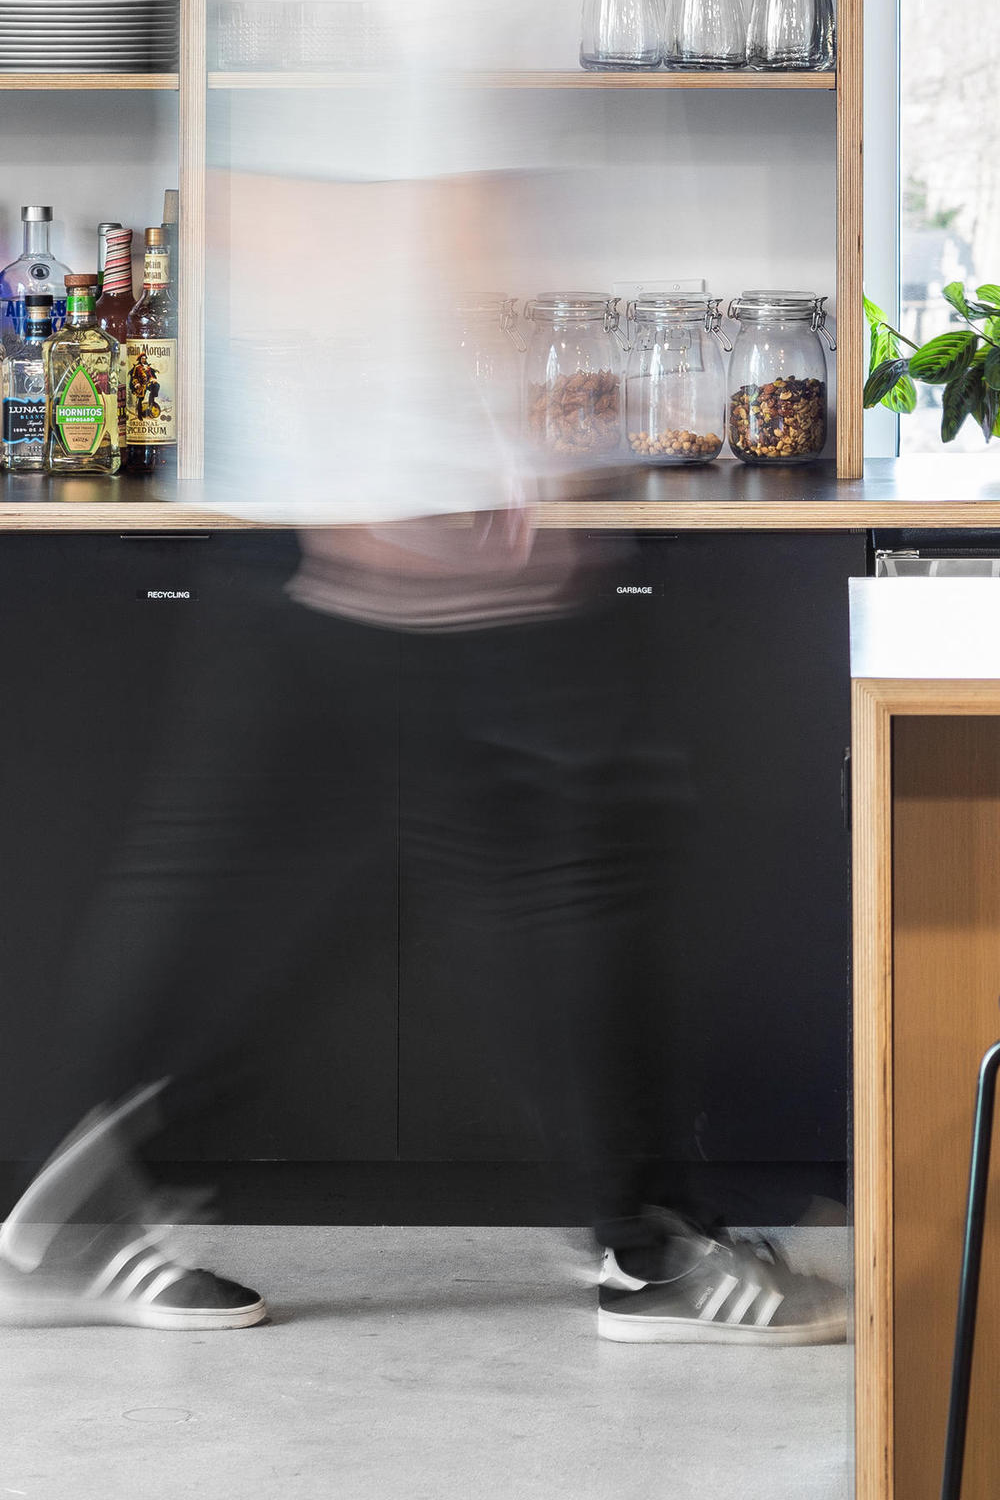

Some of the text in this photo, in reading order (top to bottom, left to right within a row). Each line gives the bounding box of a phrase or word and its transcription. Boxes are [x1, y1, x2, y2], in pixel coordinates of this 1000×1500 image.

[142, 344, 171, 358] Morgan
[9, 406, 47, 414] LUNAZ
[59, 408, 102, 417] HORNITOS
[147, 426, 168, 436] RUM
[616, 586, 653, 594] GARBAGE
[147, 591, 190, 599] RECYCLING
